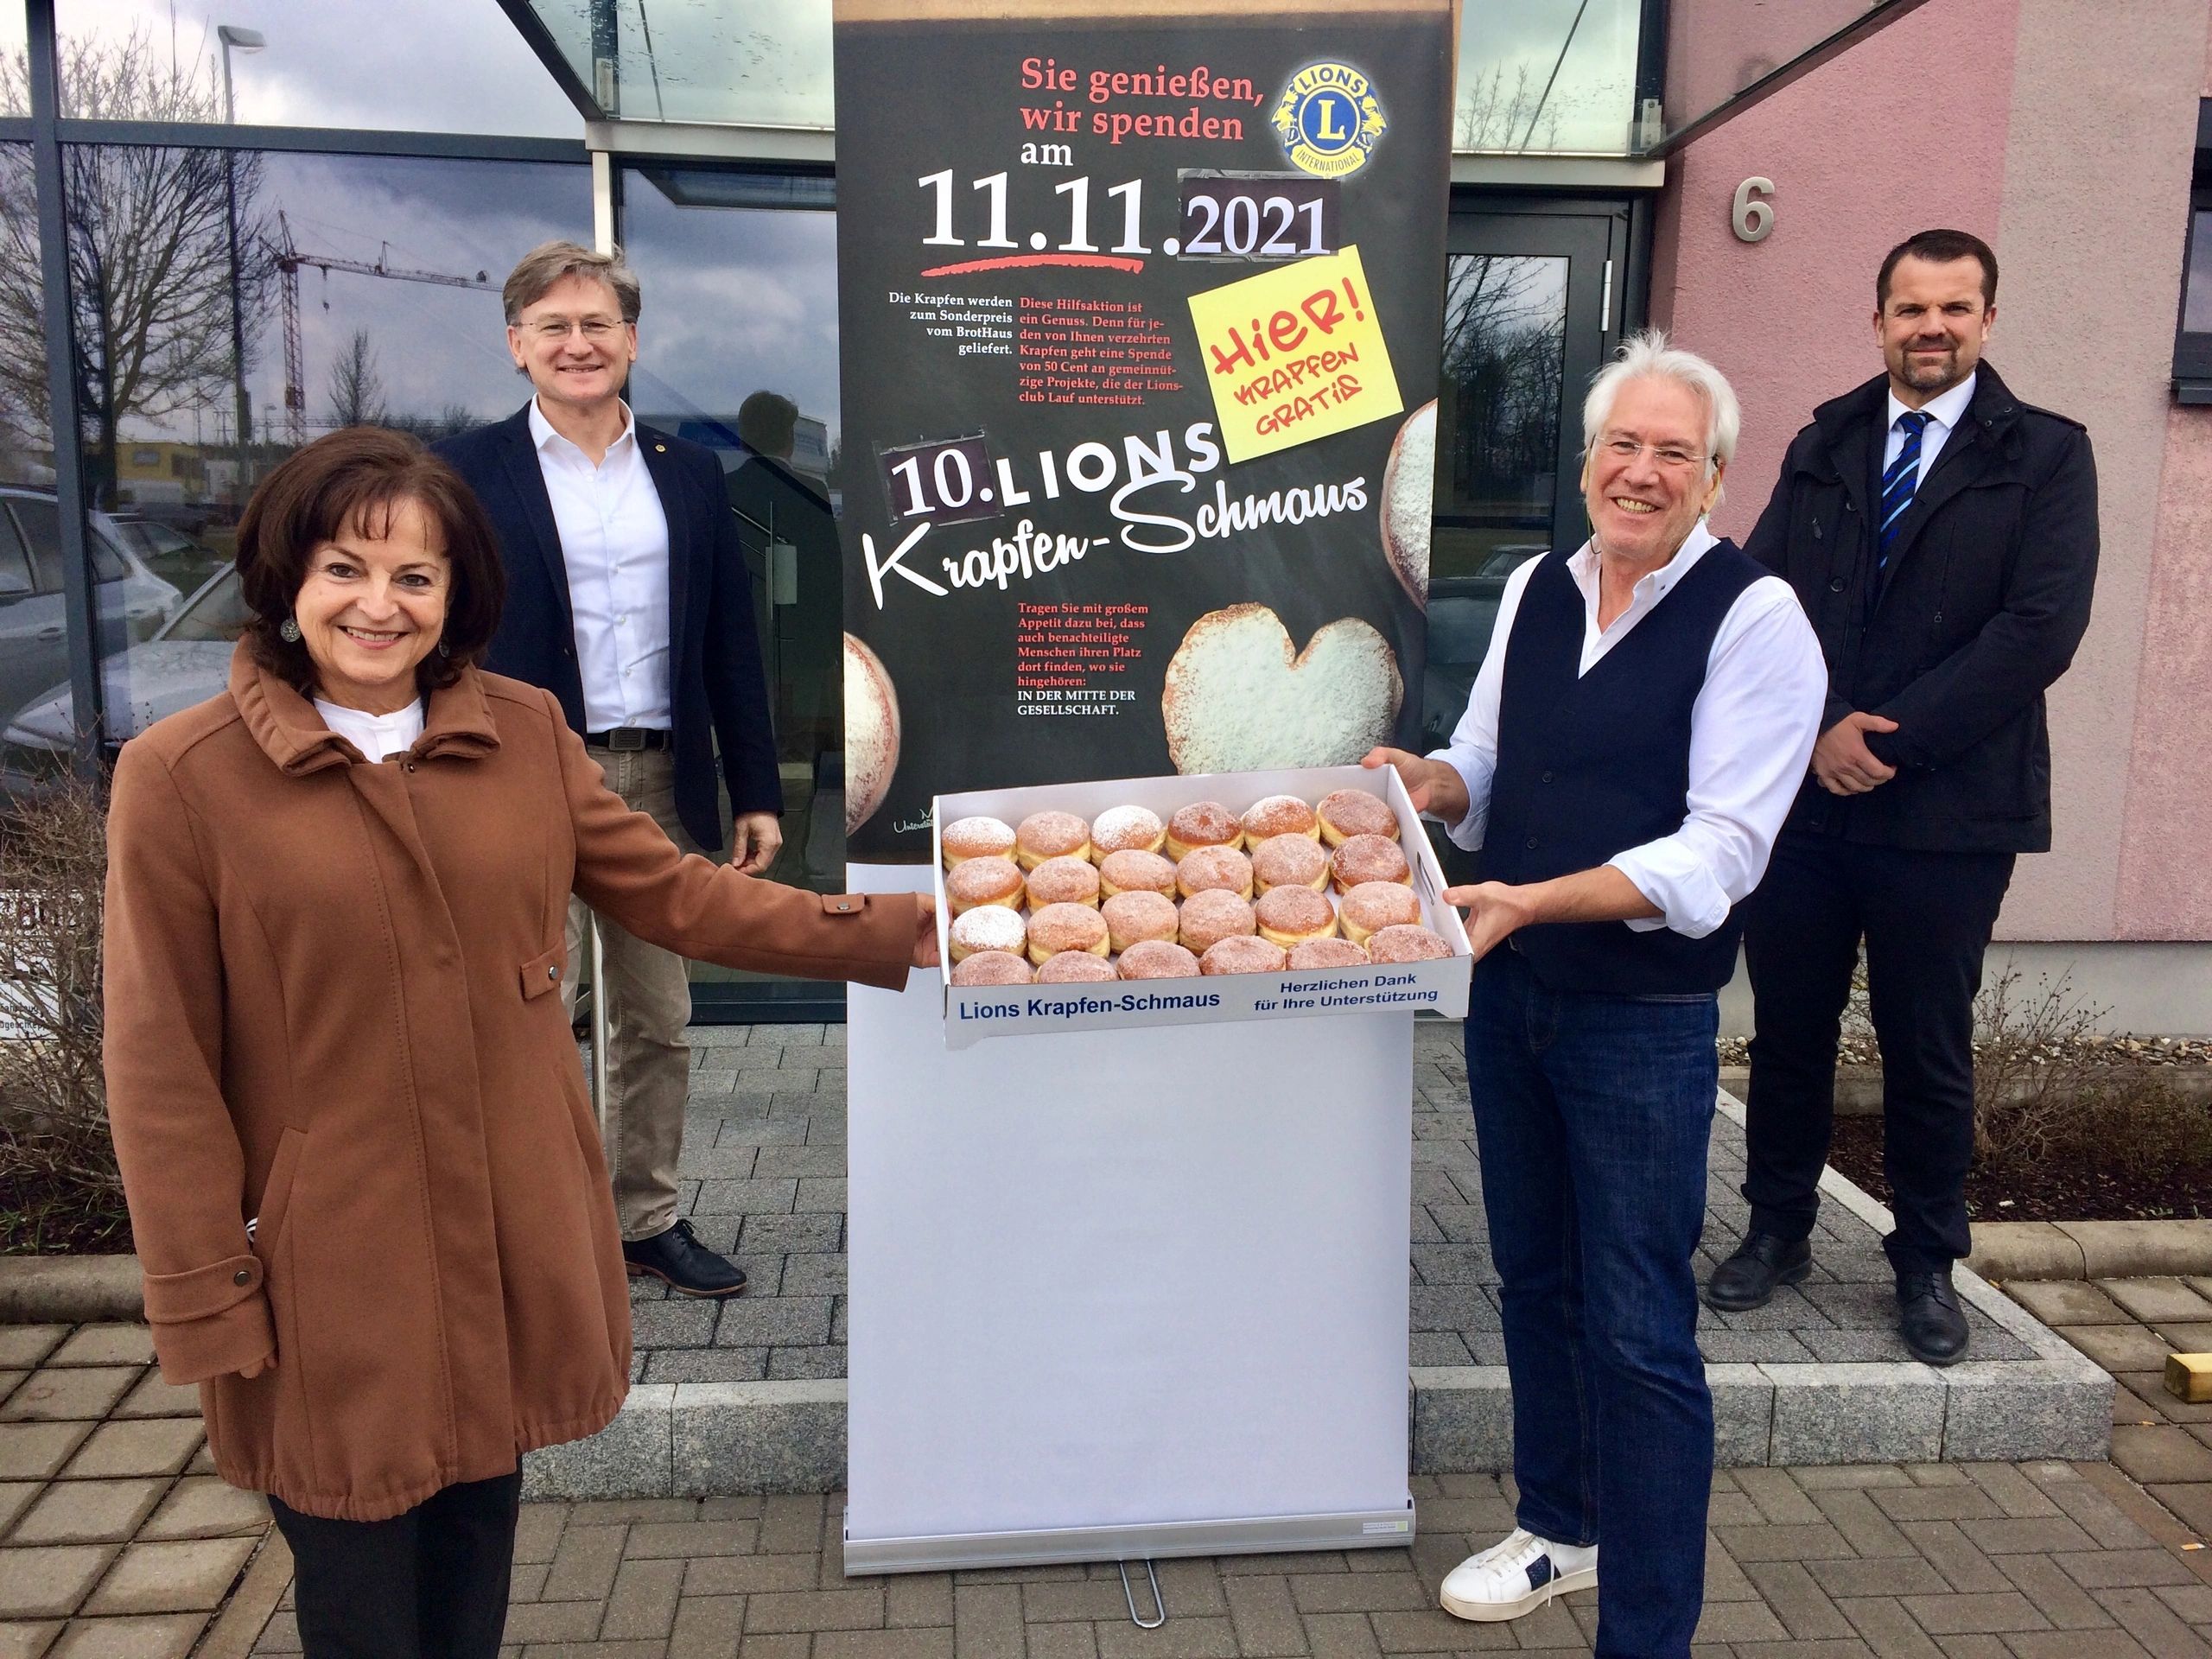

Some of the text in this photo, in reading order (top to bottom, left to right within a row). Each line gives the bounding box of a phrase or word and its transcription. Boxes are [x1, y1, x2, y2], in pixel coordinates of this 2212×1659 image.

[1020, 57, 1264, 107] Sie genießen,
[1298, 67, 1363, 93] LIONS
[1020, 100, 1244, 145] wir spenden
[1317, 99, 1346, 140] L
[1020, 141, 1074, 167] am
[1296, 149, 1362, 173] INTERNATIONAL
[1732, 175, 1776, 242] 6
[888, 292, 1013, 308] Die Krapfen werden
[1020, 297, 1142, 313] Diese Hilfsaktion ist
[910, 310, 1013, 325] zum Sonderpreis
[1020, 314, 1165, 331] ein Genuss. Denn für je-
[926, 327, 1013, 339] vom BrotHaus
[1020, 329, 1170, 344] den von Ihnen verzehrten
[958, 342, 1013, 355] geliefert.
[1020, 345, 1172, 362] Krapfen geht eine Spende
[1020, 361, 1177, 377] von 50 Cent an gemeinnüt-
[1020, 377, 1184, 391] zige Projekte, die der Lions-
[1020, 391, 1145, 405] club Lauf unterstützt.
[1018, 603, 1148, 616] Tragen Sie mit großem
[1018, 618, 1145, 630] Appetit dazu bei, dass
[1018, 632, 1129, 645] auch benachteiligte
[1018, 647, 1141, 658] Menschen ihren Platz
[1018, 662, 1041, 671] dort
[1045, 662, 1085, 673] finden,
[1109, 663, 1125, 671] sie
[1018, 677, 1086, 689] hingehören:
[1018, 691, 1135, 701] IN DER MITTE DER
[1018, 705, 1119, 715] GESELLSCHAFT.
[1280, 973, 1417, 994] Herzlichen Dank
[959, 993, 1221, 1020] Lions Krapfen-Schmaus
[1254, 989, 1439, 1011] für Ihre Unterstützung
